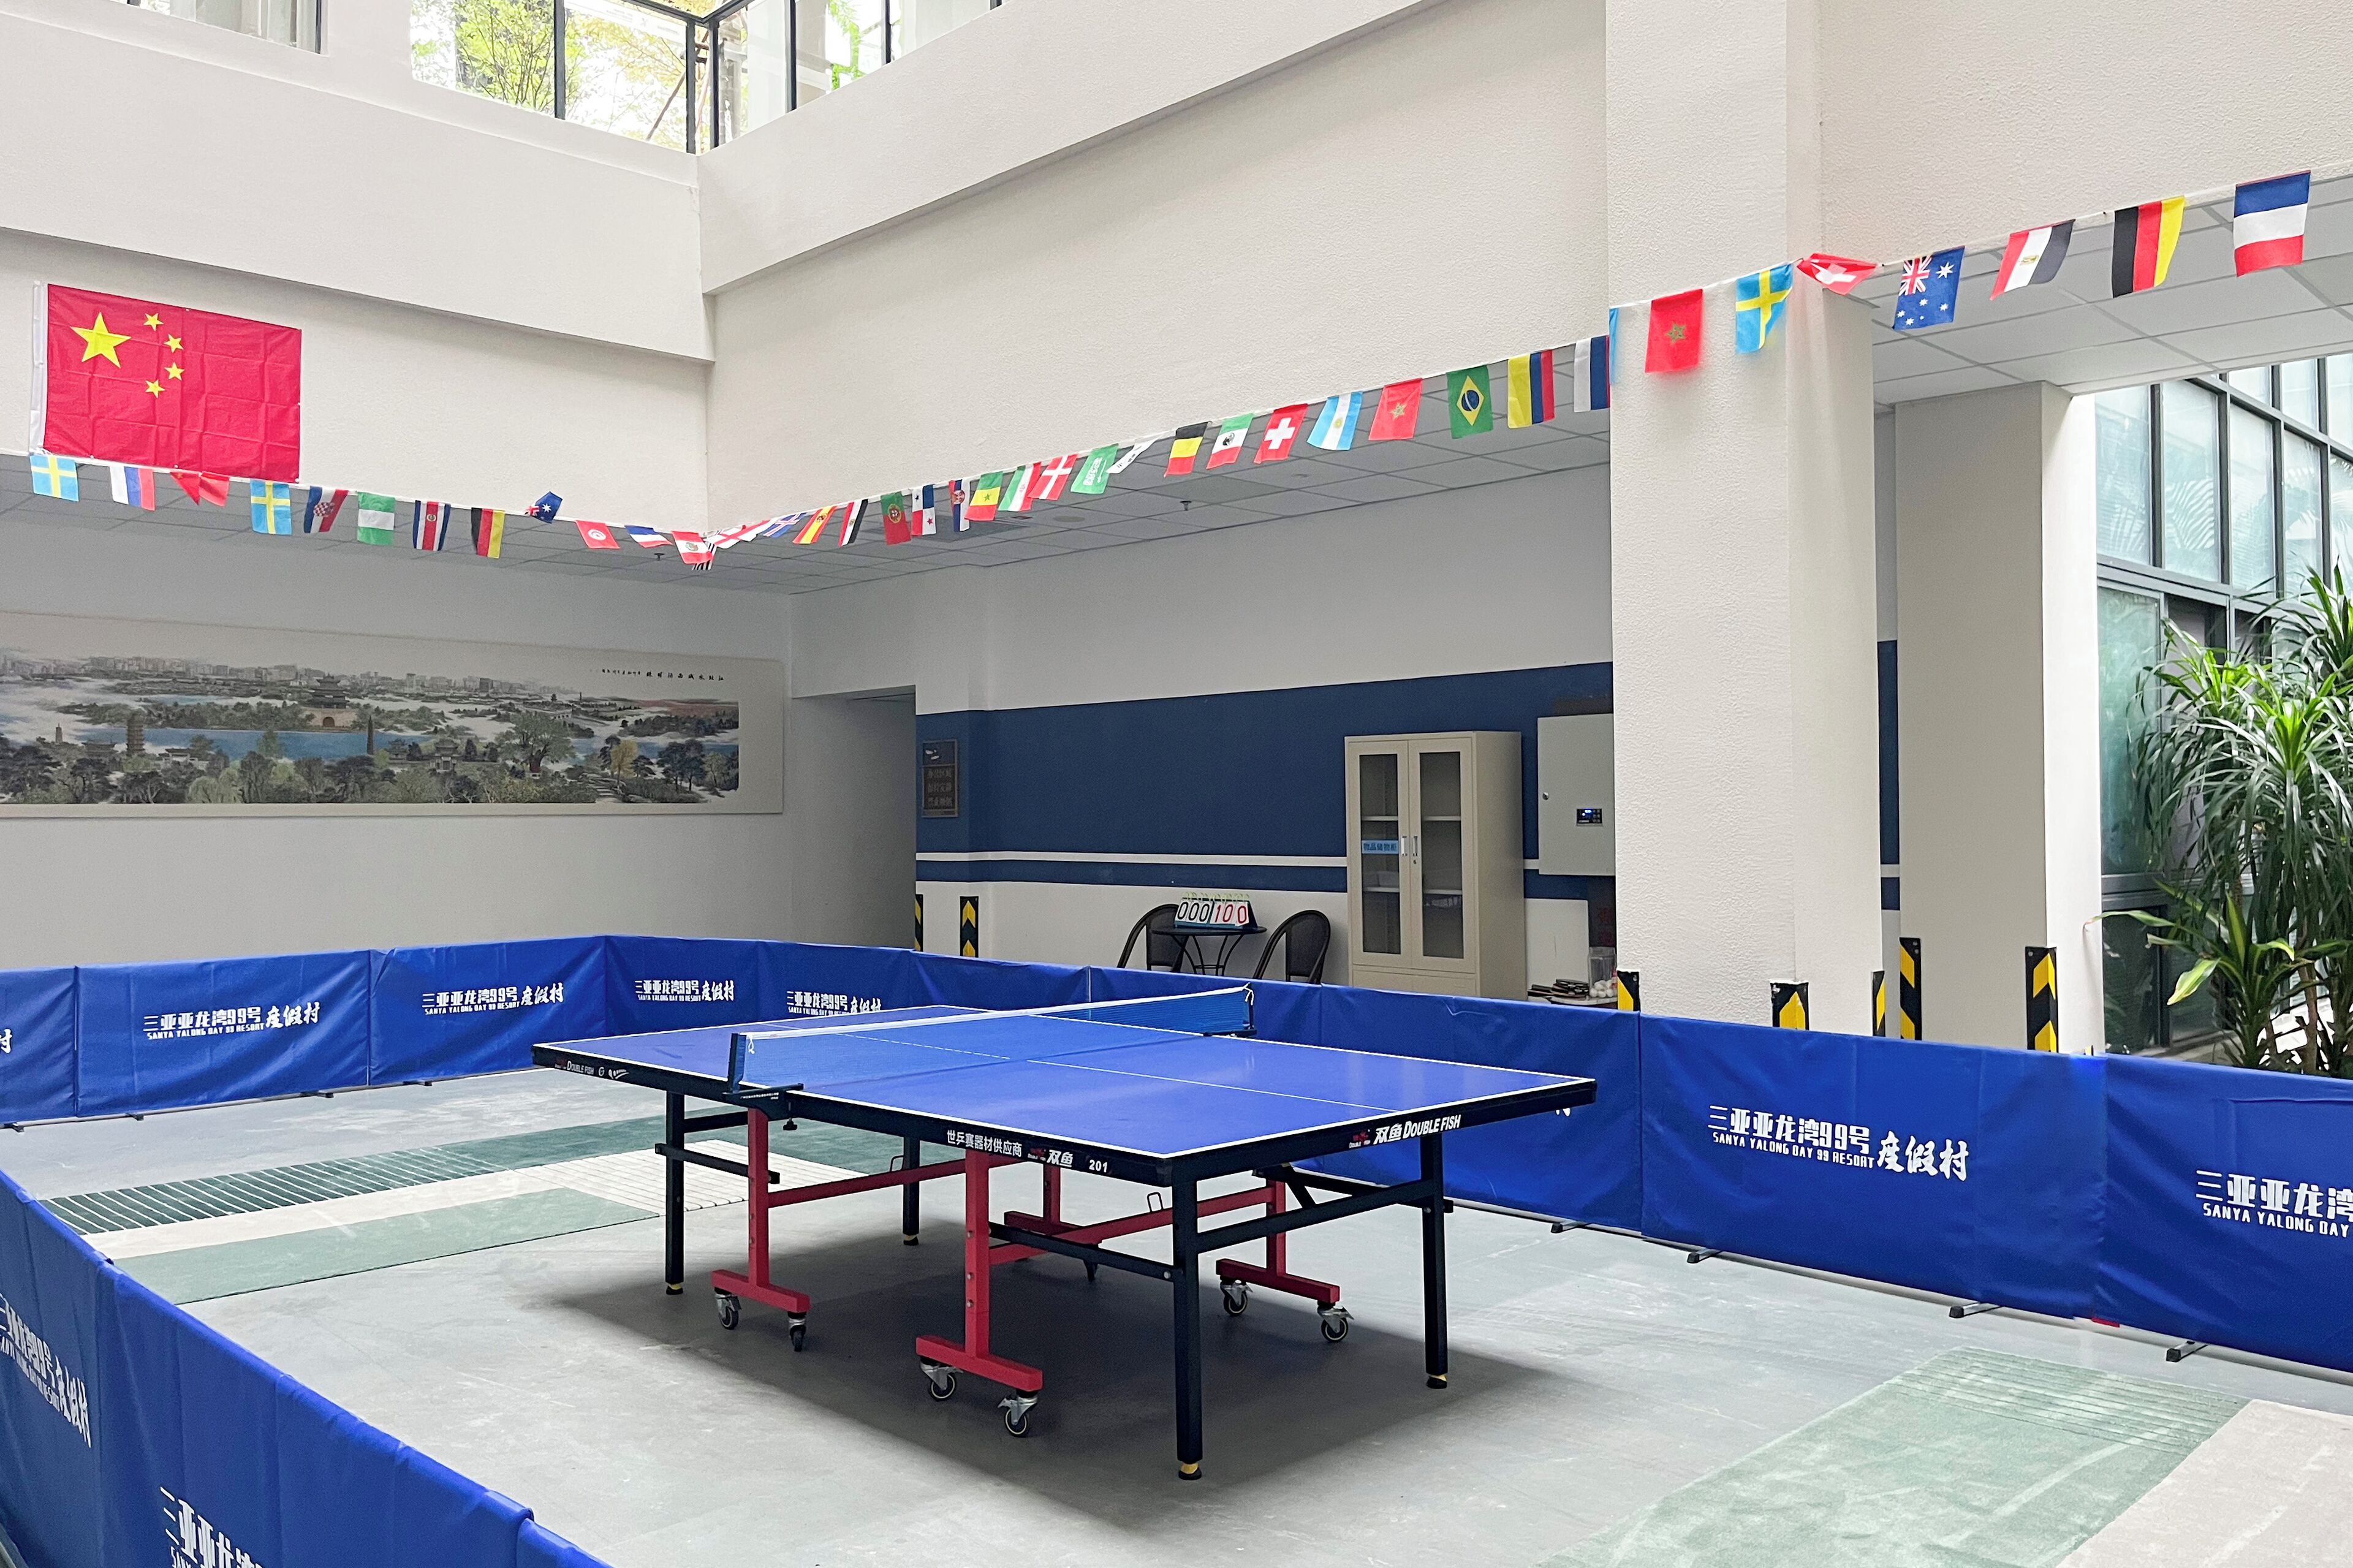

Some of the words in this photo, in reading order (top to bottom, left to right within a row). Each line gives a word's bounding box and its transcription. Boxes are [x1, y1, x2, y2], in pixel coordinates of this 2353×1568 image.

[1373, 1123, 1403, 1145] 双鱼
[1403, 1119, 1440, 1139] DOUBLE
[1441, 1114, 1461, 1132] FISH
[947, 1129, 1023, 1157] 世乒赛器材供应商
[1046, 1149, 1074, 1168] 双鱼
[1089, 1159, 1108, 1173] 201
[1713, 1132, 1745, 1148] SANYA
[1749, 1137, 1789, 1155] YALONG
[1817, 1148, 1829, 1162] 99
[1832, 1151, 1875, 1168] RESORT
[2203, 1202, 2251, 1223] SANYA
[2257, 1211, 2314, 1233] YALONG
